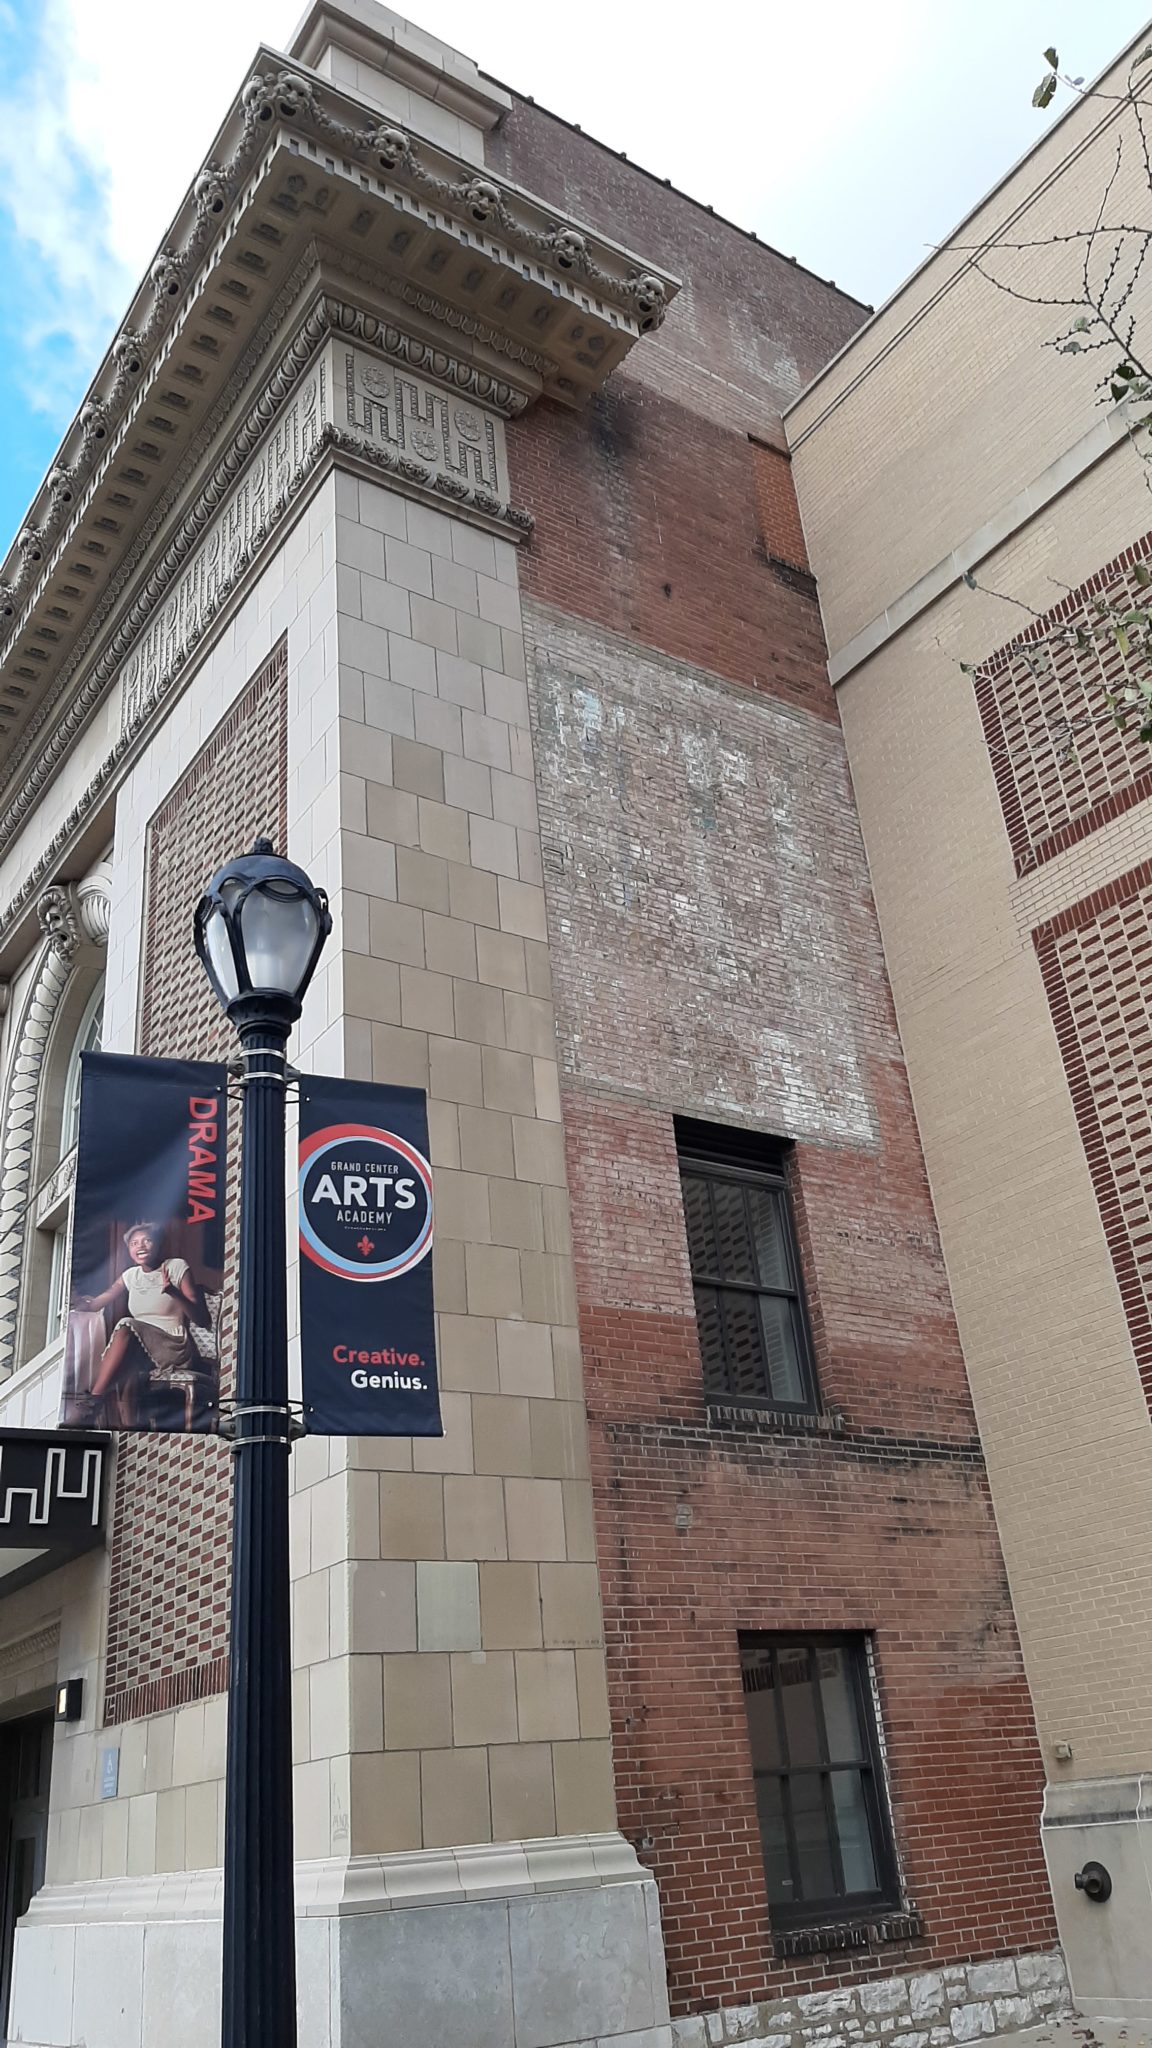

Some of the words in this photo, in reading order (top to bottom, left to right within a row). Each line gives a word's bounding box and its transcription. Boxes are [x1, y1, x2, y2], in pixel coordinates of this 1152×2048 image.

[187, 1096, 218, 1224] DRAMA
[331, 1161, 361, 1172] GRAND
[365, 1163, 399, 1174] CENTER
[311, 1174, 416, 1210] ARTS
[337, 1210, 393, 1224] ACADEMY
[333, 1345, 425, 1366] Creative.
[351, 1369, 428, 1390] Genius.
